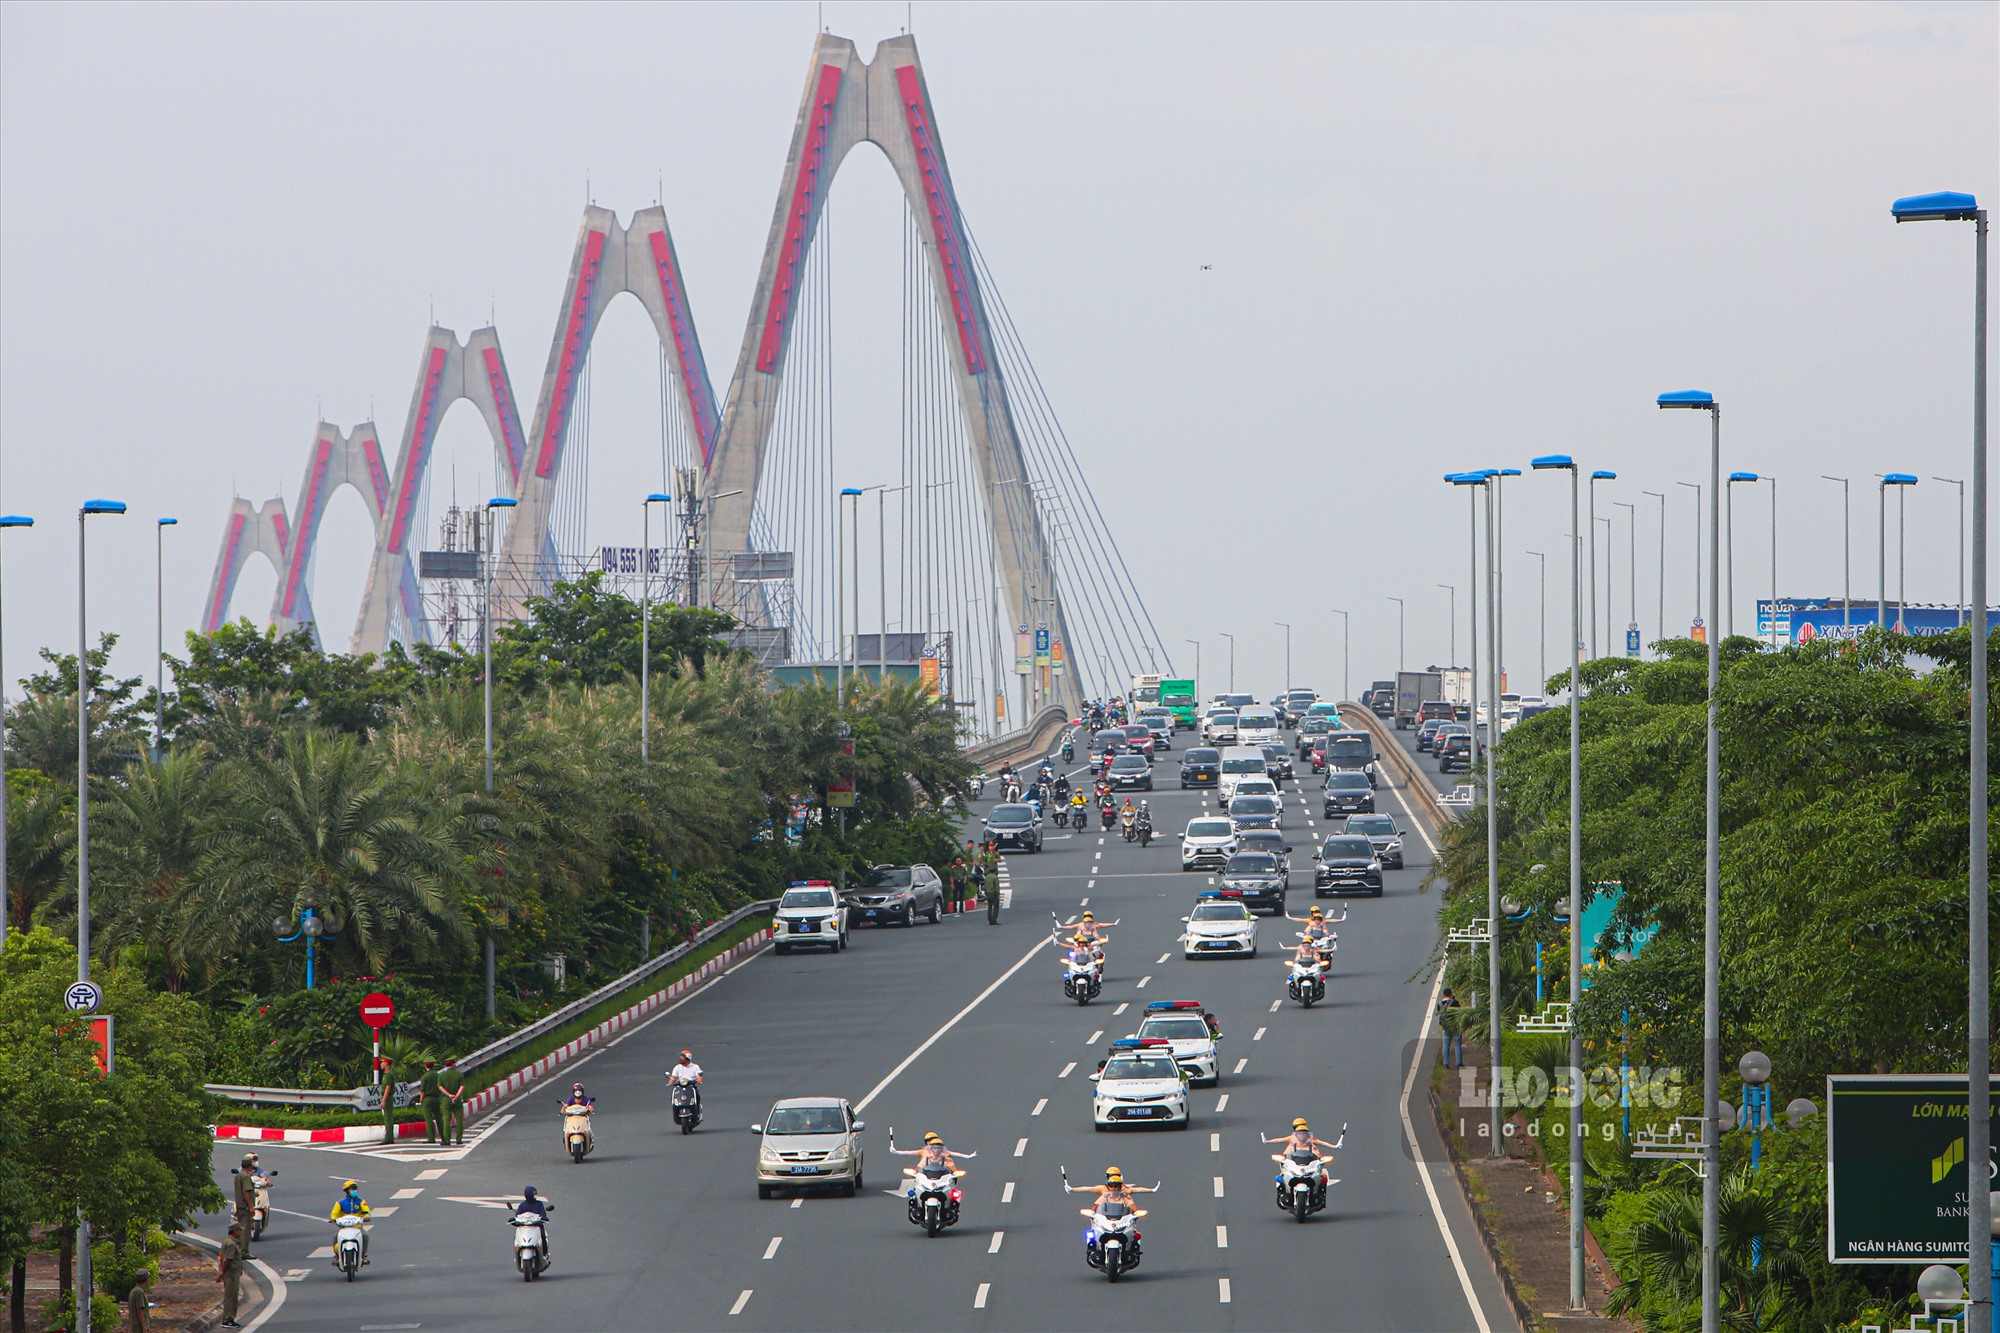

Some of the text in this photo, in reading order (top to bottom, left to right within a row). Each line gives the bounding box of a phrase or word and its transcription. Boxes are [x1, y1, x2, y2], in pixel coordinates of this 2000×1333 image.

[602, 547, 660, 573] 094 555 185
[1912, 1101, 1944, 1118] LỚN
[1848, 1239, 1884, 1252] NGÂN
[1887, 1239, 1923, 1252] HÀNG
